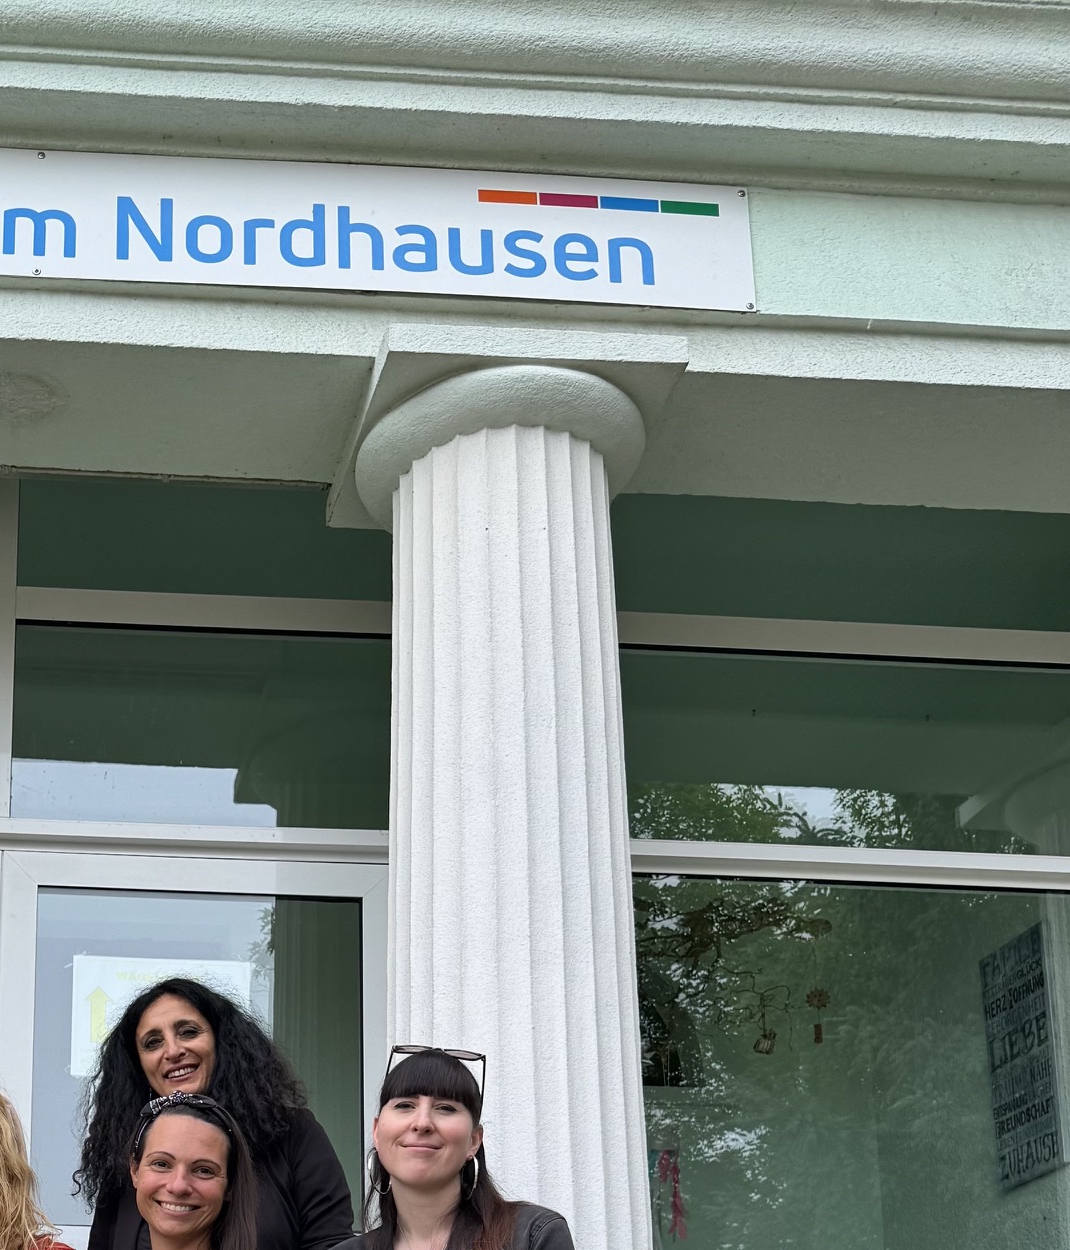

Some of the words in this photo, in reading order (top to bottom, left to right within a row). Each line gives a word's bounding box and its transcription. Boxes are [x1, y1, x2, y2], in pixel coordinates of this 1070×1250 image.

[116, 197, 654, 286] Nordhausen
[1015, 954, 1042, 981] GLÜCK
[983, 992, 1007, 1023] HERZ
[986, 991, 1046, 1040] GEBORGENHEIT
[987, 1008, 1049, 1074] LIEBE
[994, 1093, 1056, 1139] FREUNDSCHAFT
[997, 1127, 1060, 1183] ZUHAUSE
